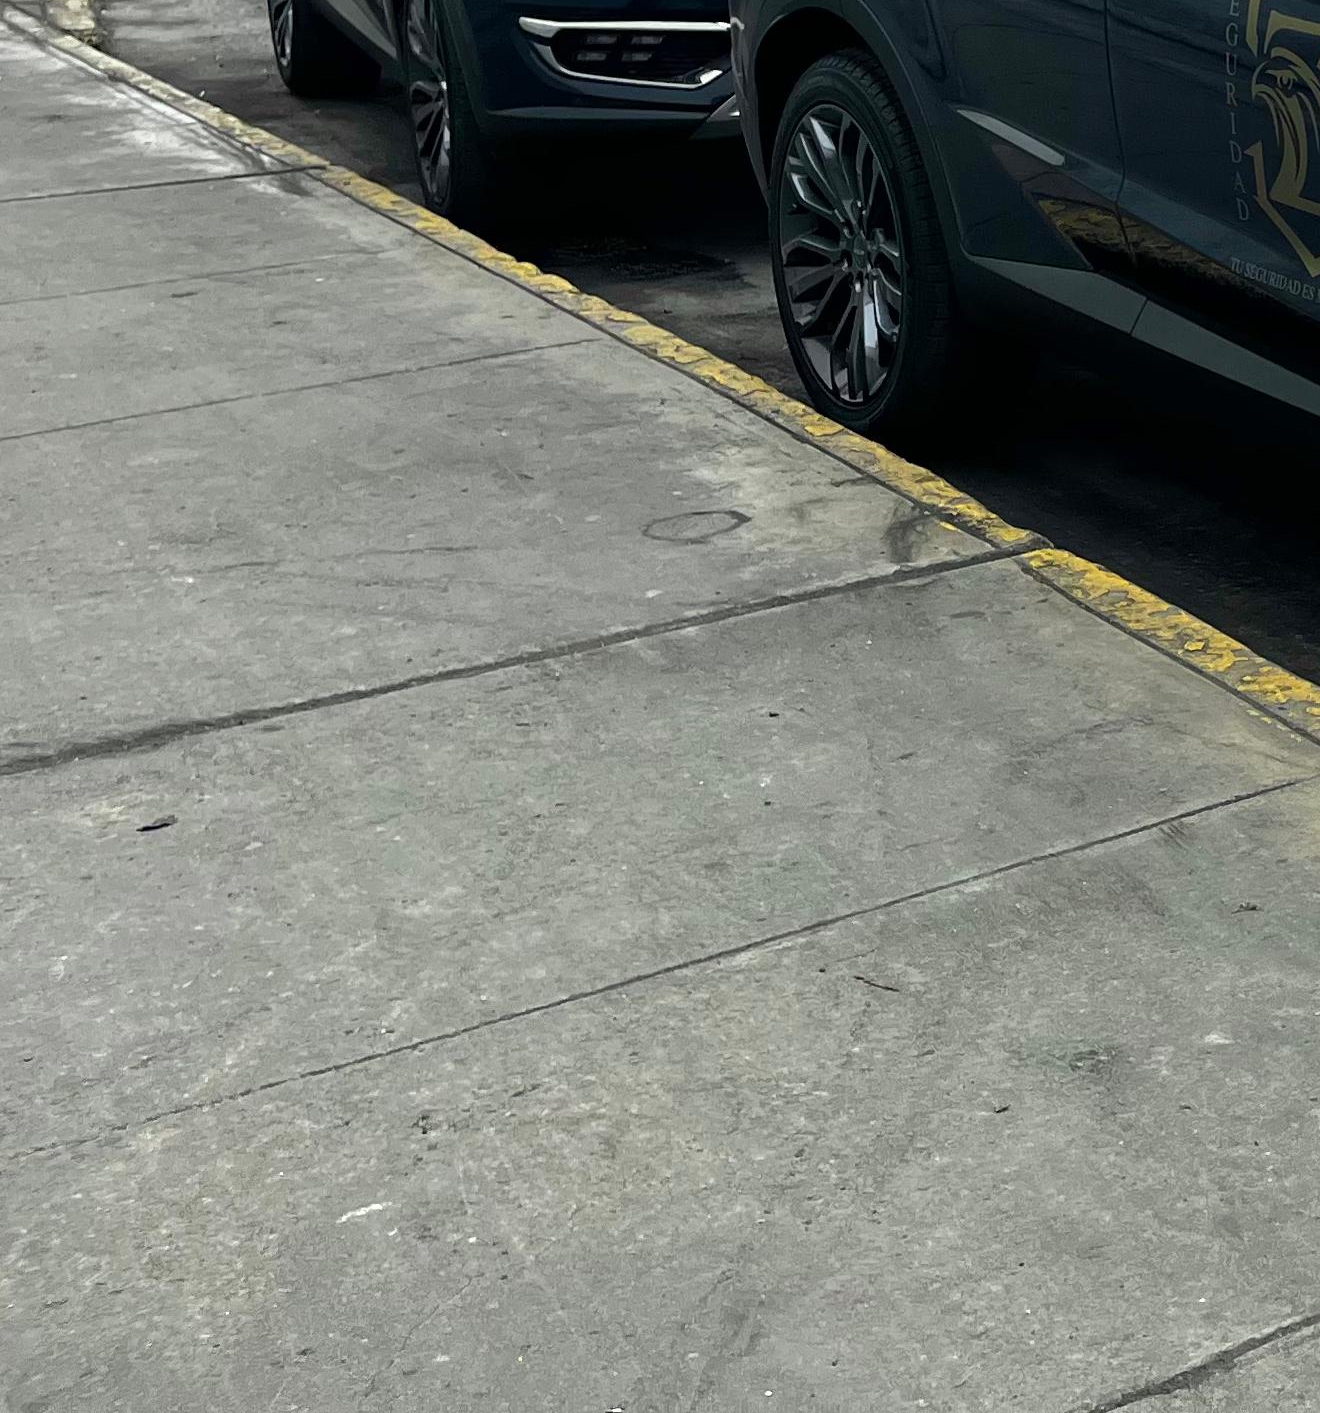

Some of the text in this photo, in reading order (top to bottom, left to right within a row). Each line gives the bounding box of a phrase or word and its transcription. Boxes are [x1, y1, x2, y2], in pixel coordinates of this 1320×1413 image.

[1230, 257, 1244, 275] TU
[1244, 262, 1301, 295] SEGURIDAD
[1302, 283, 1316, 300] ES
